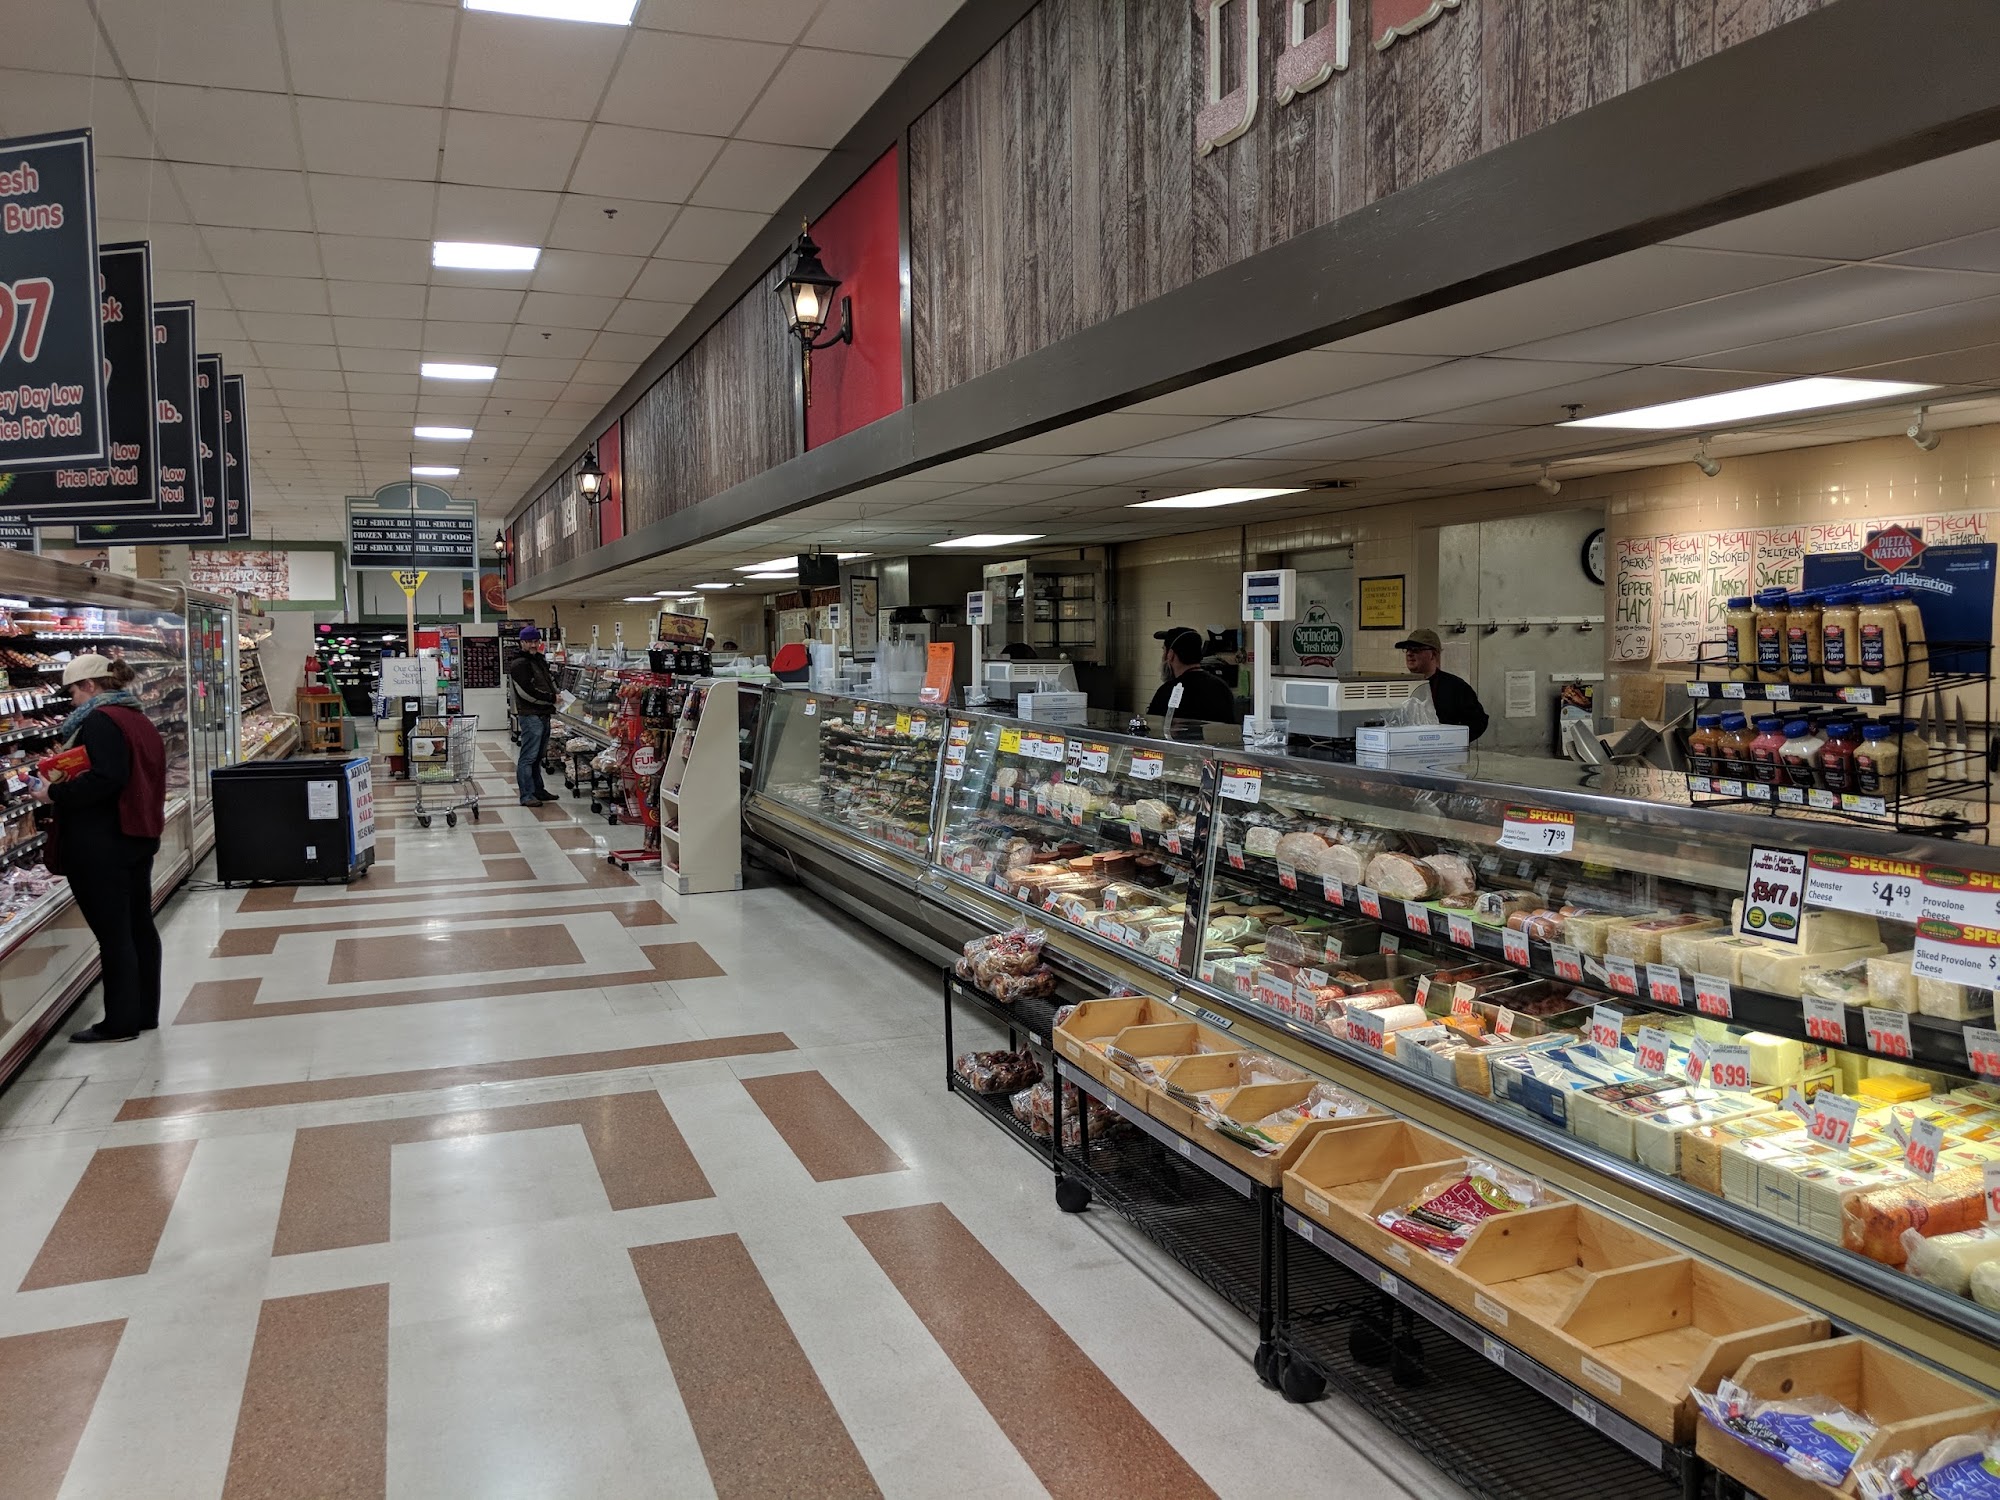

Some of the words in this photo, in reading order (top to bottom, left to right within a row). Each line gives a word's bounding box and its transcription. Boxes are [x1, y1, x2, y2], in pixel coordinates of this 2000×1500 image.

[0, 161, 39, 196] esh
[4, 203, 64, 234] Buns
[101, 296, 123, 323] ok
[0, 277, 54, 363] 97
[0, 390, 18, 414] ery
[20, 384, 49, 413] Day
[52, 382, 84, 401] Low
[159, 399, 183, 424] lb.
[0, 423, 21, 441] ice
[23, 419, 46, 440] For
[49, 411, 82, 437] You!
[113, 442, 140, 460] Low
[56, 469, 87, 488] Price
[89, 468, 109, 487] For
[109, 466, 139, 485] You!
[162, 466, 185, 482] Low
[160, 486, 185, 503] You!
[406, 486, 420, 509] 1
[352, 519, 367, 527] SELF
[369, 519, 395, 528] SERVICE
[396, 520, 412, 528] DELI
[415, 519, 431, 529] FULL
[432, 520, 457, 529] SERVICE
[458, 521, 473, 530] DELI
[1926, 513, 1987, 536] SPECIAL
[0, 527, 33, 537] TIONAL
[353, 531, 383, 540] FROZEN
[385, 532, 412, 540] MEATS
[418, 532, 438, 541] HOT
[441, 533, 472, 541] FOODS
[1708, 531, 1752, 548] SPECIAL
[1757, 528, 1806, 547] SPECIAL
[1810, 524, 1859, 542] SPECIAL
[353, 543, 368, 552] SELF
[369, 544, 394, 552] SERVICE
[395, 544, 412, 553] MEAT
[431, 545, 455, 554] SERVICE
[456, 546, 473, 554] MEAT
[1616, 540, 1655, 556] SPECIAL
[1658, 537, 1703, 555] SPECIAL
[1878, 536, 1904, 548] DIETZ
[1904, 536, 1912, 546] &
[1708, 550, 1750, 567] SMOKED
[1871, 547, 1913, 559] WATSON
[190, 570, 212, 581] GE
[218, 570, 283, 582] MARKET
[399, 574, 420, 586] CUT
[1661, 567, 1701, 590] TAVERN
[1708, 566, 1748, 597] TURKEY
[1755, 562, 1803, 588] SWEET
[1881, 572, 1954, 594] Grillebration
[1617, 571, 1653, 598] PEPPER
[1616, 598, 1652, 625] HAM
[1661, 590, 1698, 620] HAM
[1303, 642, 1320, 653] Fresh
[1320, 642, 1339, 653] Foods
[1759, 652, 1779, 662] Mayo
[1789, 652, 1808, 662] Mayo
[1824, 651, 1845, 661] Mayo
[1862, 652, 1884, 662] Mayo
[393, 665, 408, 673] Our
[407, 664, 427, 672] Clean
[401, 671, 419, 679] Store
[393, 677, 411, 685] Starts
[1236, 767, 1262, 779] SPECIAL!
[358, 781, 368, 792] FOR
[358, 807, 373, 823] SALE
[1529, 809, 1575, 825] SPECIAL!
[1778, 855, 1795, 865] Martin
[1849, 855, 1922, 878] SPECIAL!
[1809, 878, 1844, 892] Muenster
[1808, 889, 1834, 902] Cheese
[1922, 896, 1966, 912] Provolone
[1921, 908, 1951, 922] Cheese
[1963, 925, 2000, 945] SPEC
[1915, 961, 1944, 975] Cheese
[1916, 949, 1939, 963] Sliced
[1940, 954, 1983, 971] Provolone
[1791, 1100, 1811, 1120] SPECIAL
[1892, 1127, 1908, 1147] SPECIAL
[1961, 1461, 2000, 1492] LET
